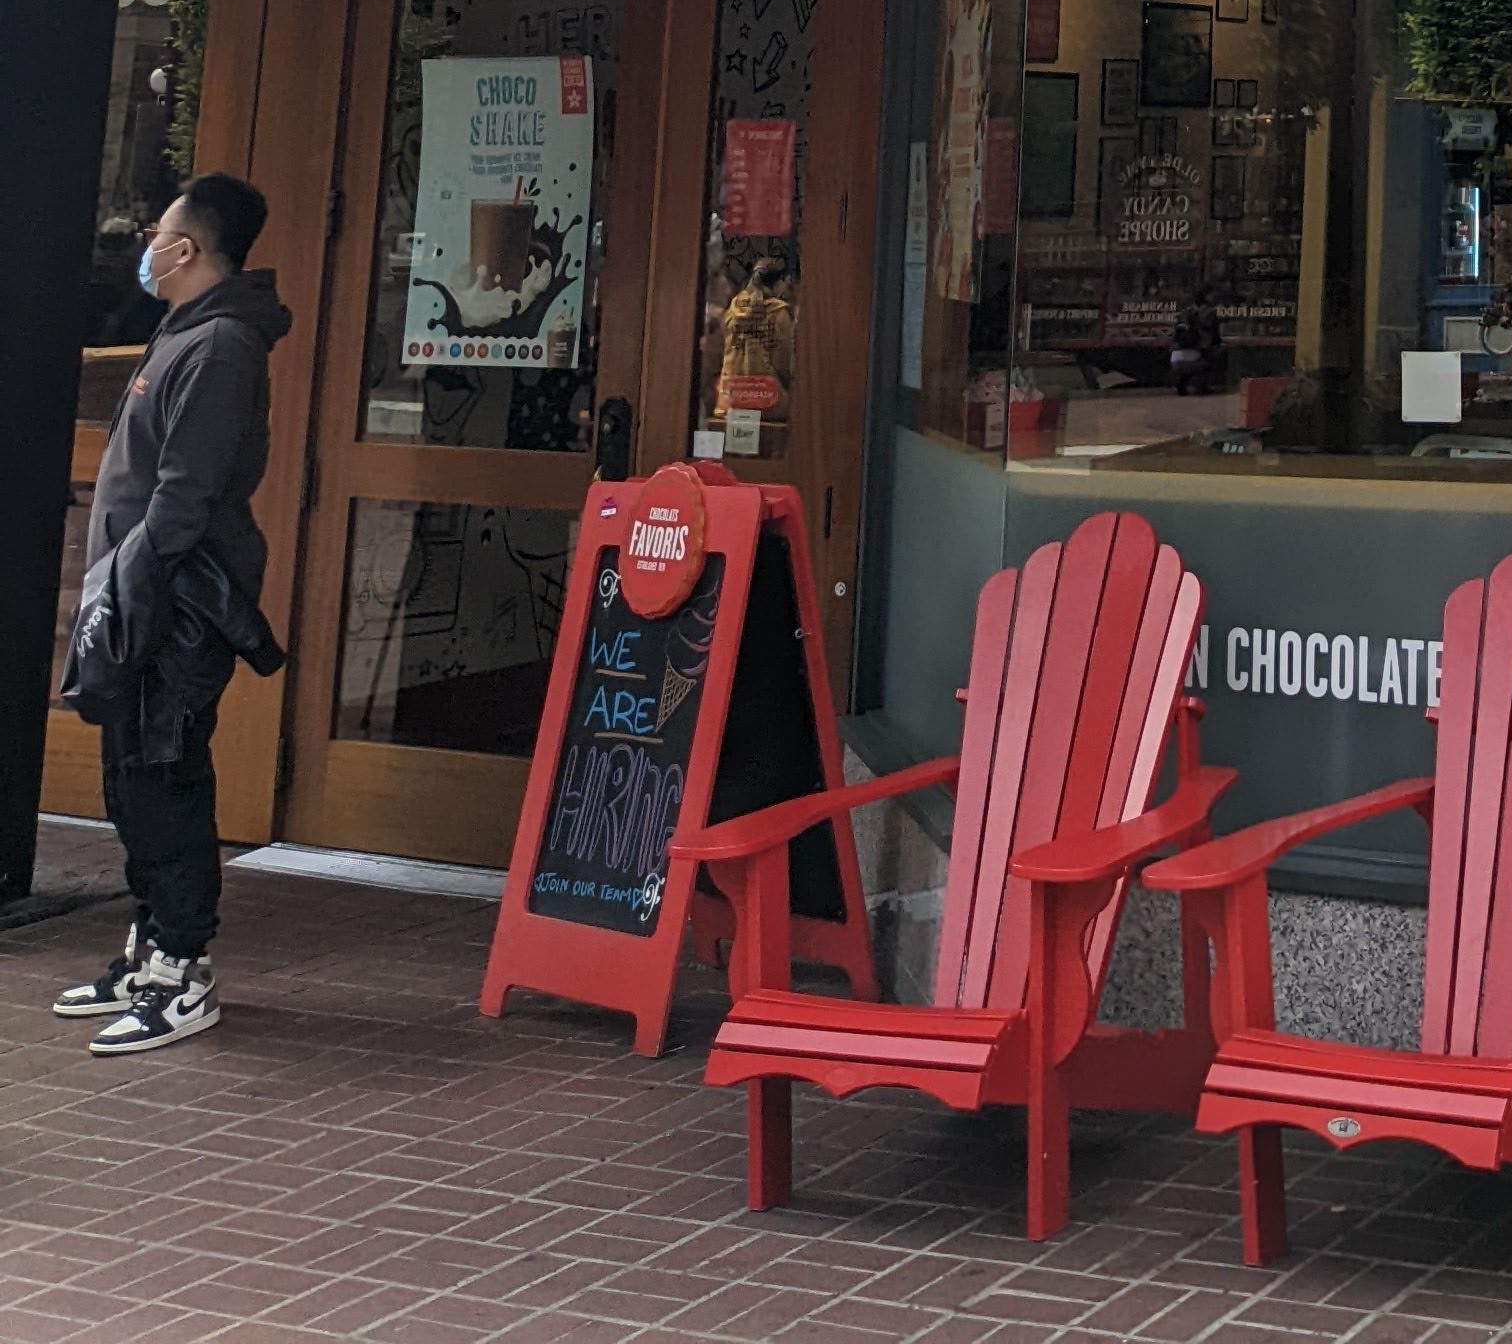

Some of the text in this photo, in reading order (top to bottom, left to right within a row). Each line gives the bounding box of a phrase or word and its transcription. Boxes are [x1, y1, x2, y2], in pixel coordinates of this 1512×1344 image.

[477, 75, 537, 106] CHOCO
[470, 111, 546, 146] SHAKE
[732, 426, 754, 438] Uber
[649, 506, 680, 523] CHOCOLATS
[628, 520, 690, 562] FAVORIS
[590, 627, 641, 671] WE
[584, 685, 656, 734] ARE
[549, 743, 685, 878] HIRING
[572, 880, 597, 897] OUR
